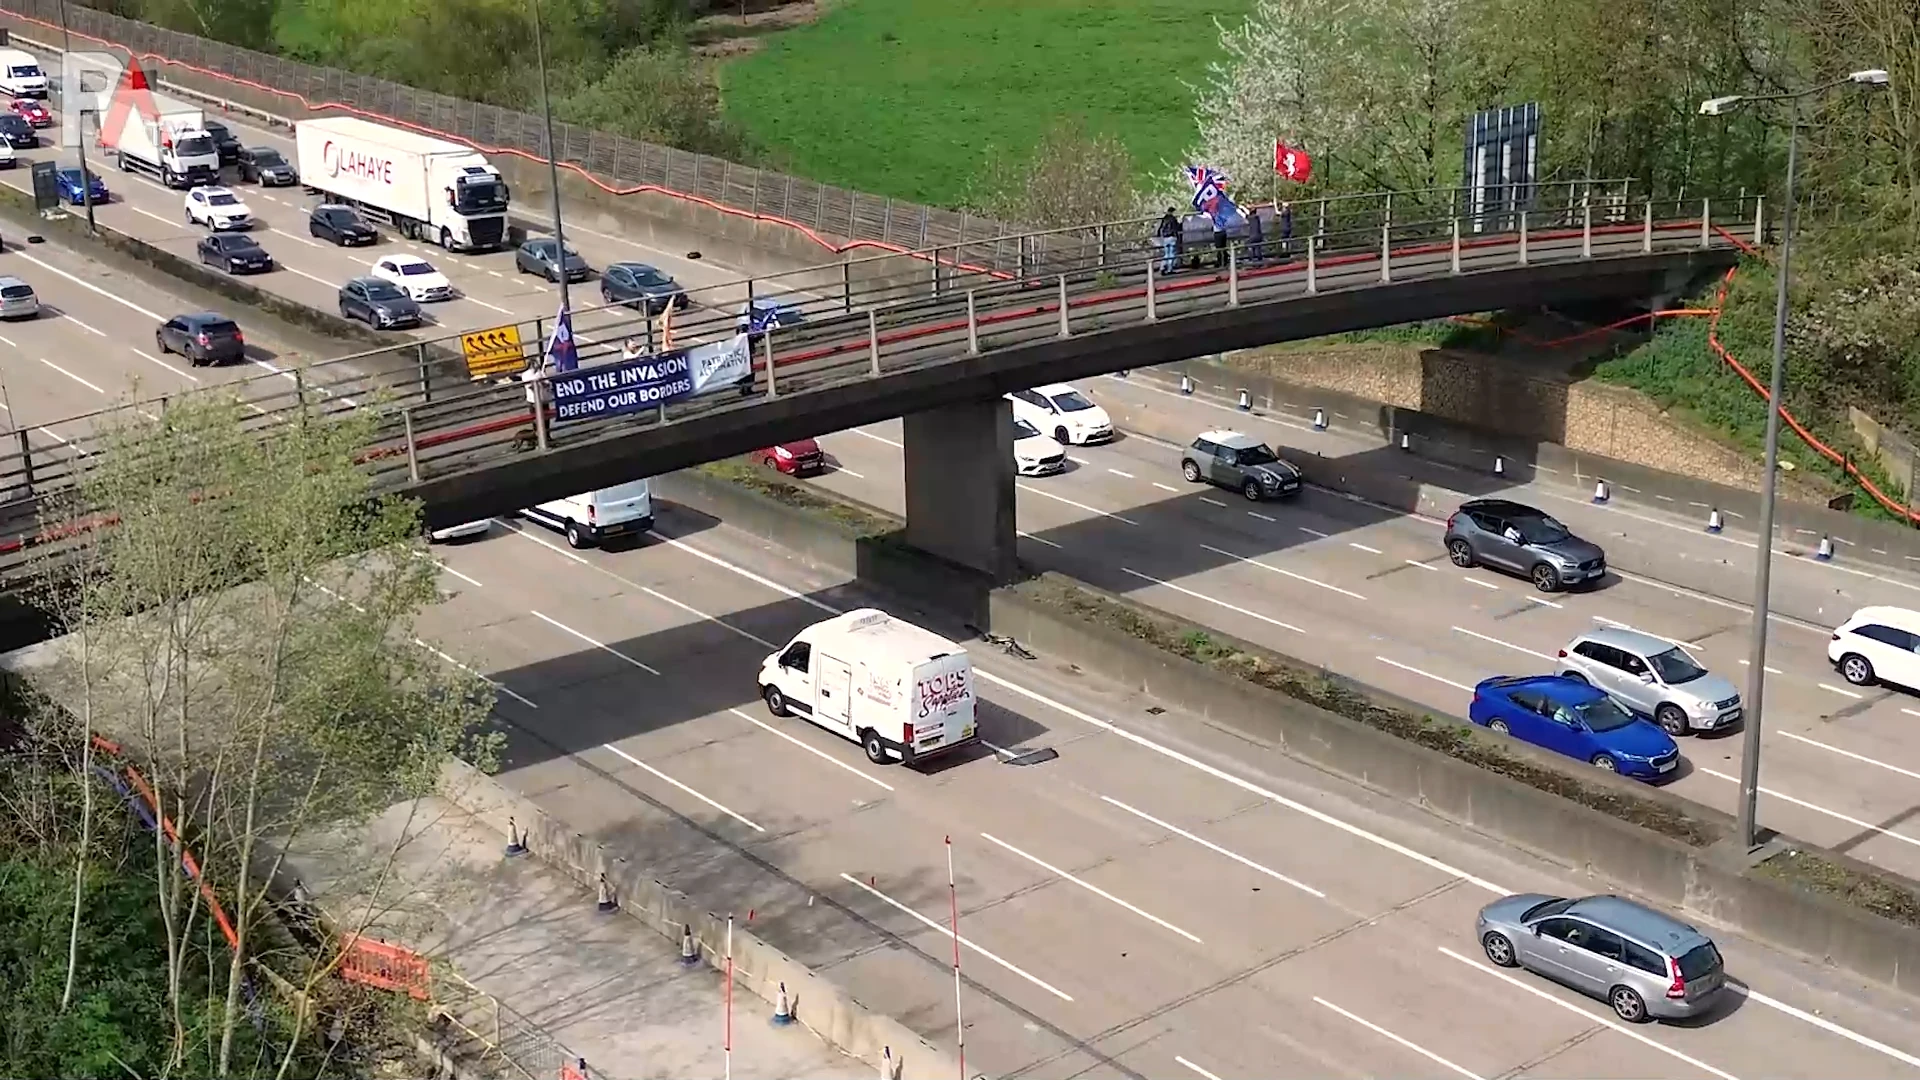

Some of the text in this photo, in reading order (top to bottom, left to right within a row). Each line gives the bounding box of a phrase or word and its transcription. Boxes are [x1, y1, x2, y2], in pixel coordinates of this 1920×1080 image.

[340, 147, 392, 184] LAHAYE
[556, 357, 687, 398] END THE INVASION
[559, 378, 691, 418] DEFEND OUR BORDERS
